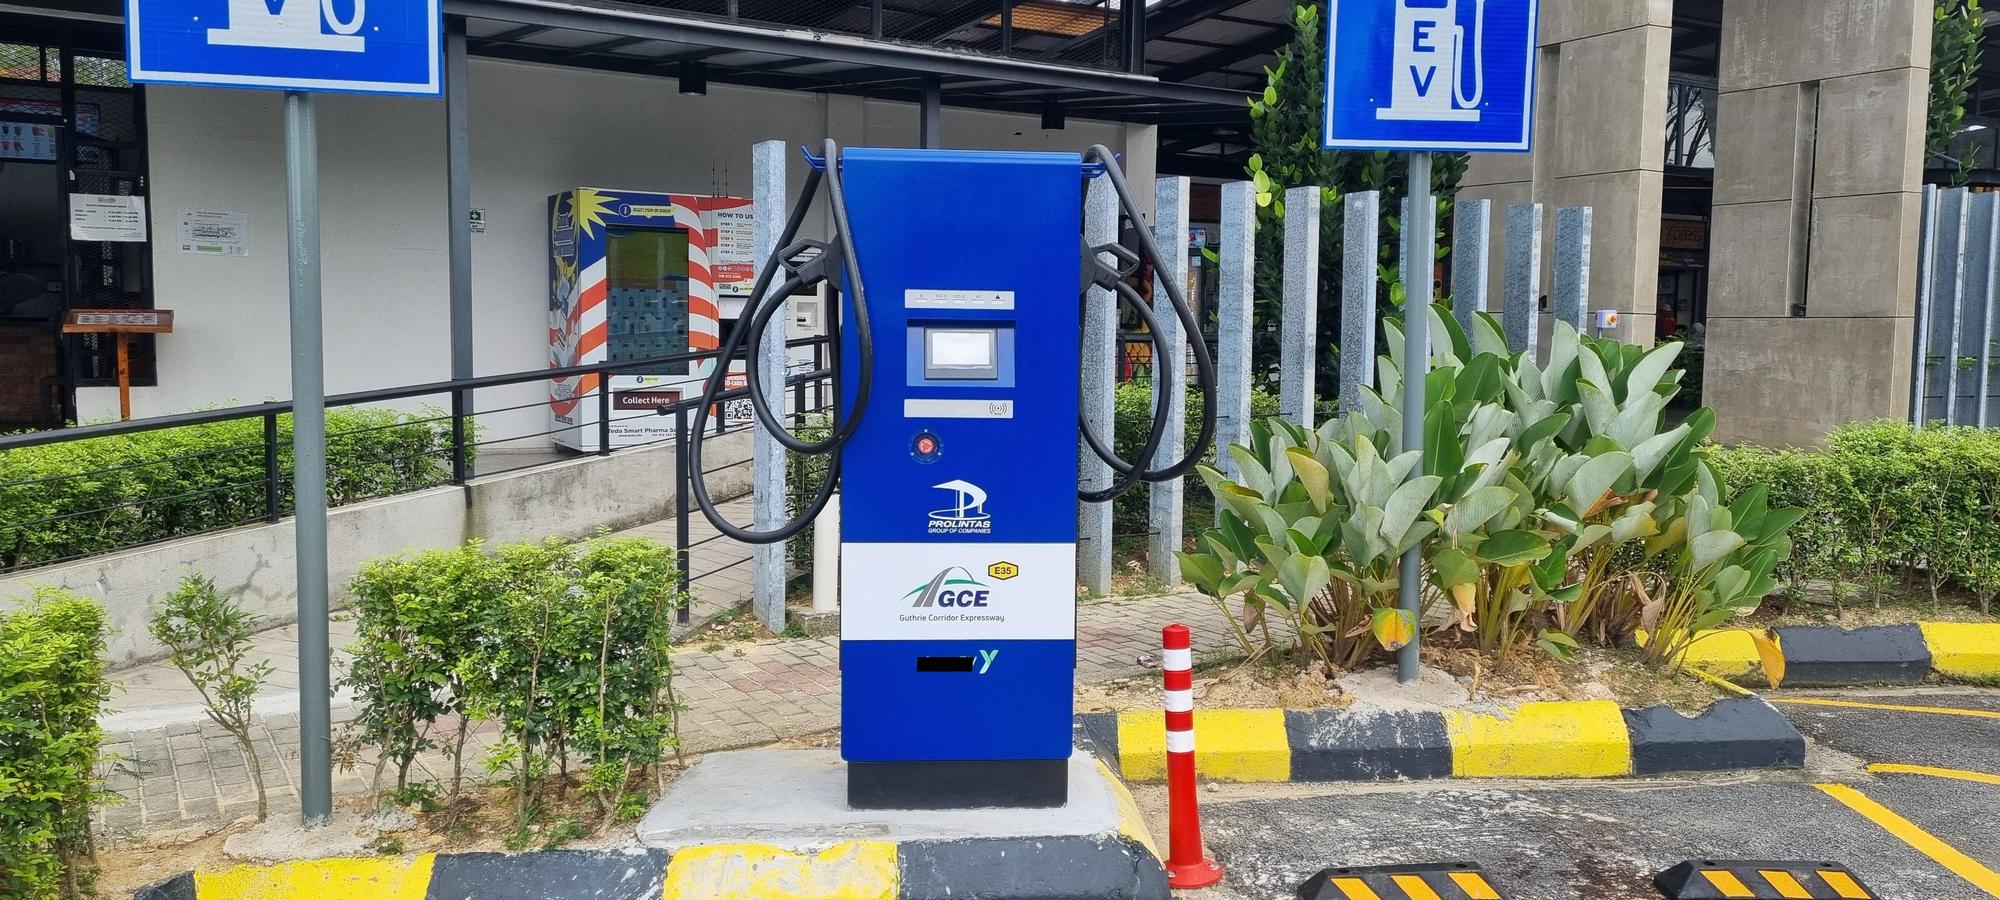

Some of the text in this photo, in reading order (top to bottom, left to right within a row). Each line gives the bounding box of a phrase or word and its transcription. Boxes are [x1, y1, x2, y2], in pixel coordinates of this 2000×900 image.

[622, 396, 670, 404] Collect Here
[928, 520, 991, 528] PROLINTAS
[994, 566, 1012, 575] E35
[938, 590, 990, 608] GCE
[899, 614, 1005, 623] Guthrie Corridor Expressway
